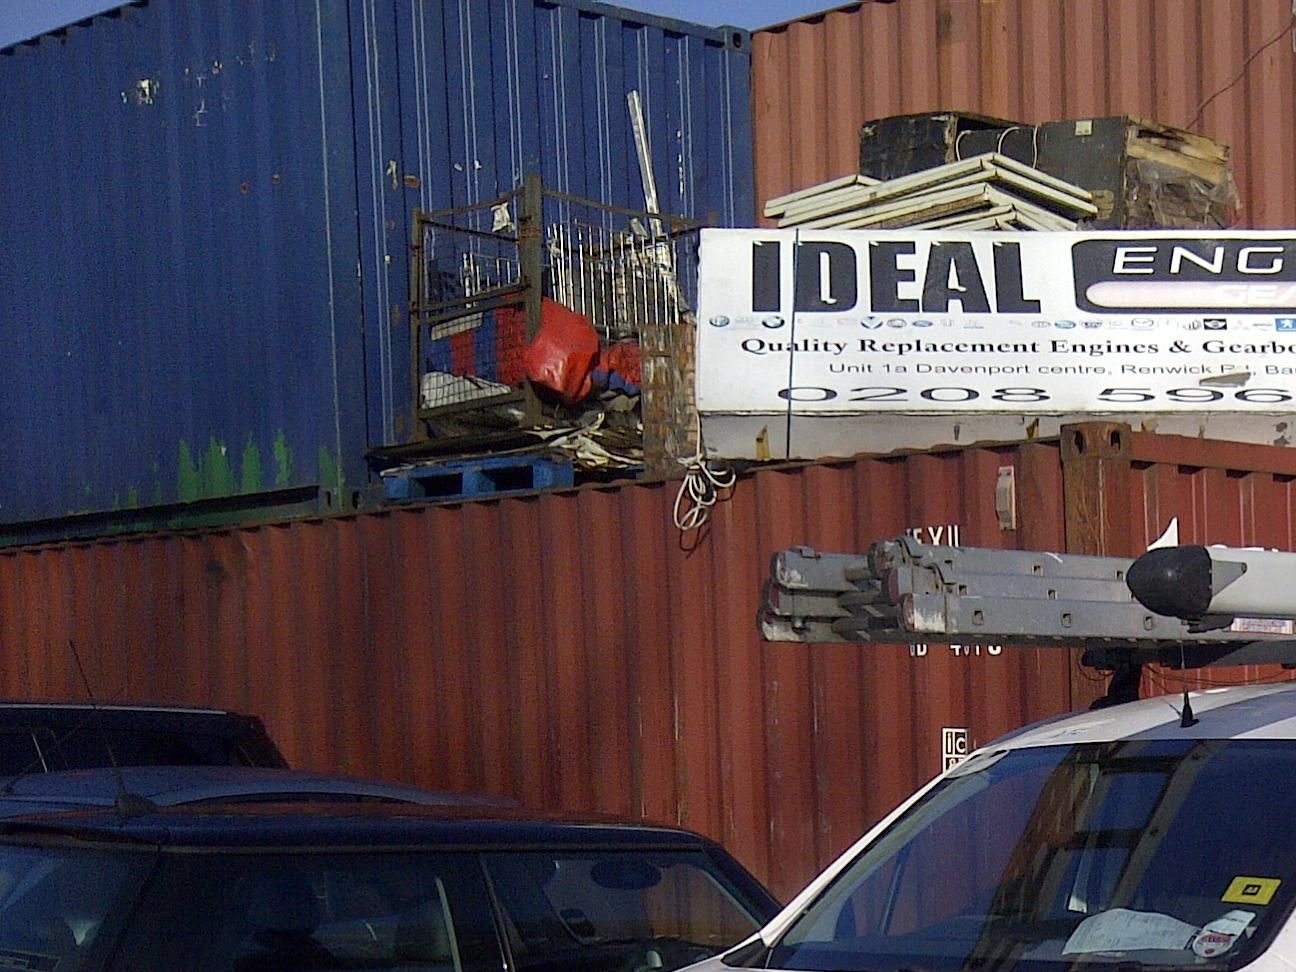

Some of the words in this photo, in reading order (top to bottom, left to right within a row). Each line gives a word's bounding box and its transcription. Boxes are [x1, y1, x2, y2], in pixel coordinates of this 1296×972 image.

[752, 241, 1041, 313] IDEAL
[741, 338, 848, 355] Quality
[859, 338, 1040, 356] Replacement
[1049, 339, 1159, 357] Engines
[1168, 340, 1192, 354] &
[829, 363, 872, 374] Unit
[882, 363, 907, 374] 1a
[916, 363, 1030, 377] Davenport
[1121, 364, 1212, 375] Renwick
[778, 387, 1051, 402] 0208
[1097, 387, 1292, 403] 596
